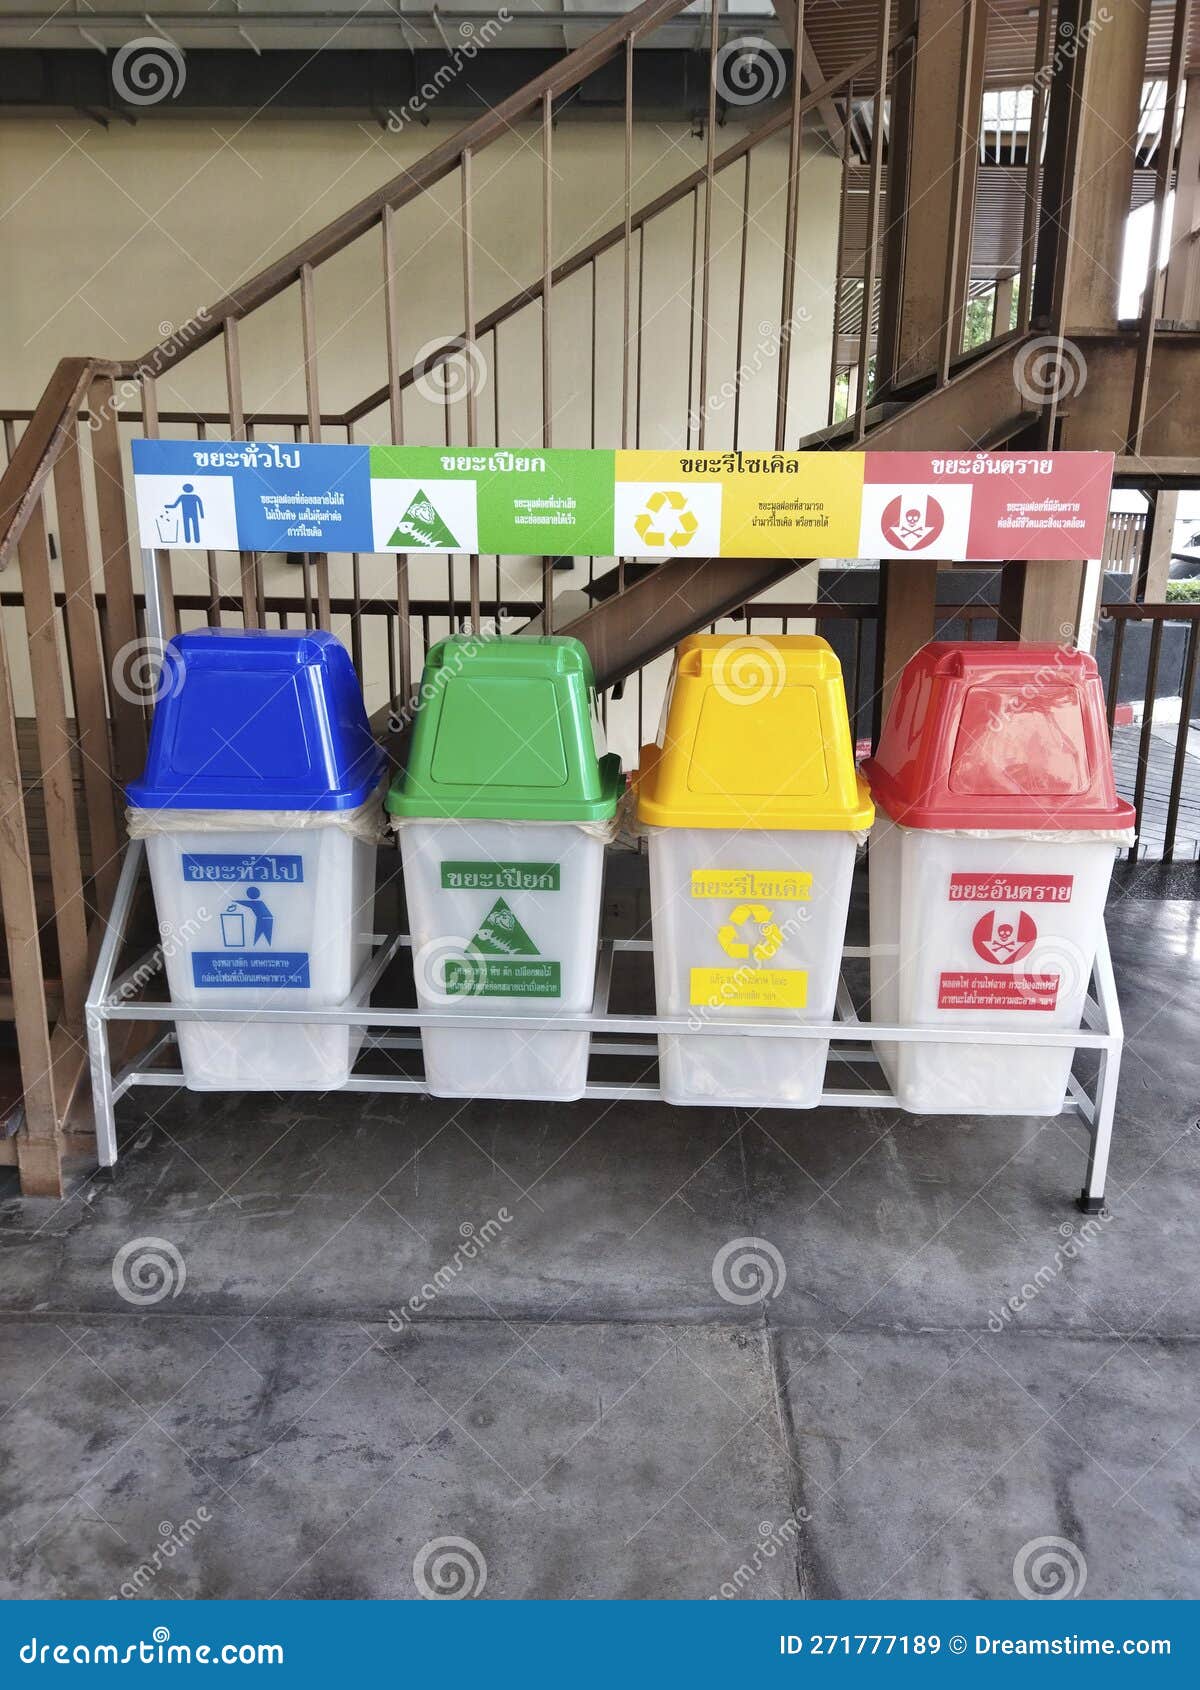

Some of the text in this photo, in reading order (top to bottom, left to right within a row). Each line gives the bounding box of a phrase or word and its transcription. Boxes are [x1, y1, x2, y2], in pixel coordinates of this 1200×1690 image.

[193, 443, 301, 469] ขยะทั่วไป
[440, 451, 546, 473] ขยะเปียก
[680, 451, 799, 474] ขยะรีไซเคิล
[931, 453, 1053, 475] ขยะอันตราย
[758, 498, 824, 514] ขยะมูลฝอยที่สามารถ
[188, 856, 298, 880] ขยะทั่วไป
[447, 868, 554, 889] ขยะเปียก
[950, 879, 1071, 900] ขยะอันตราย
